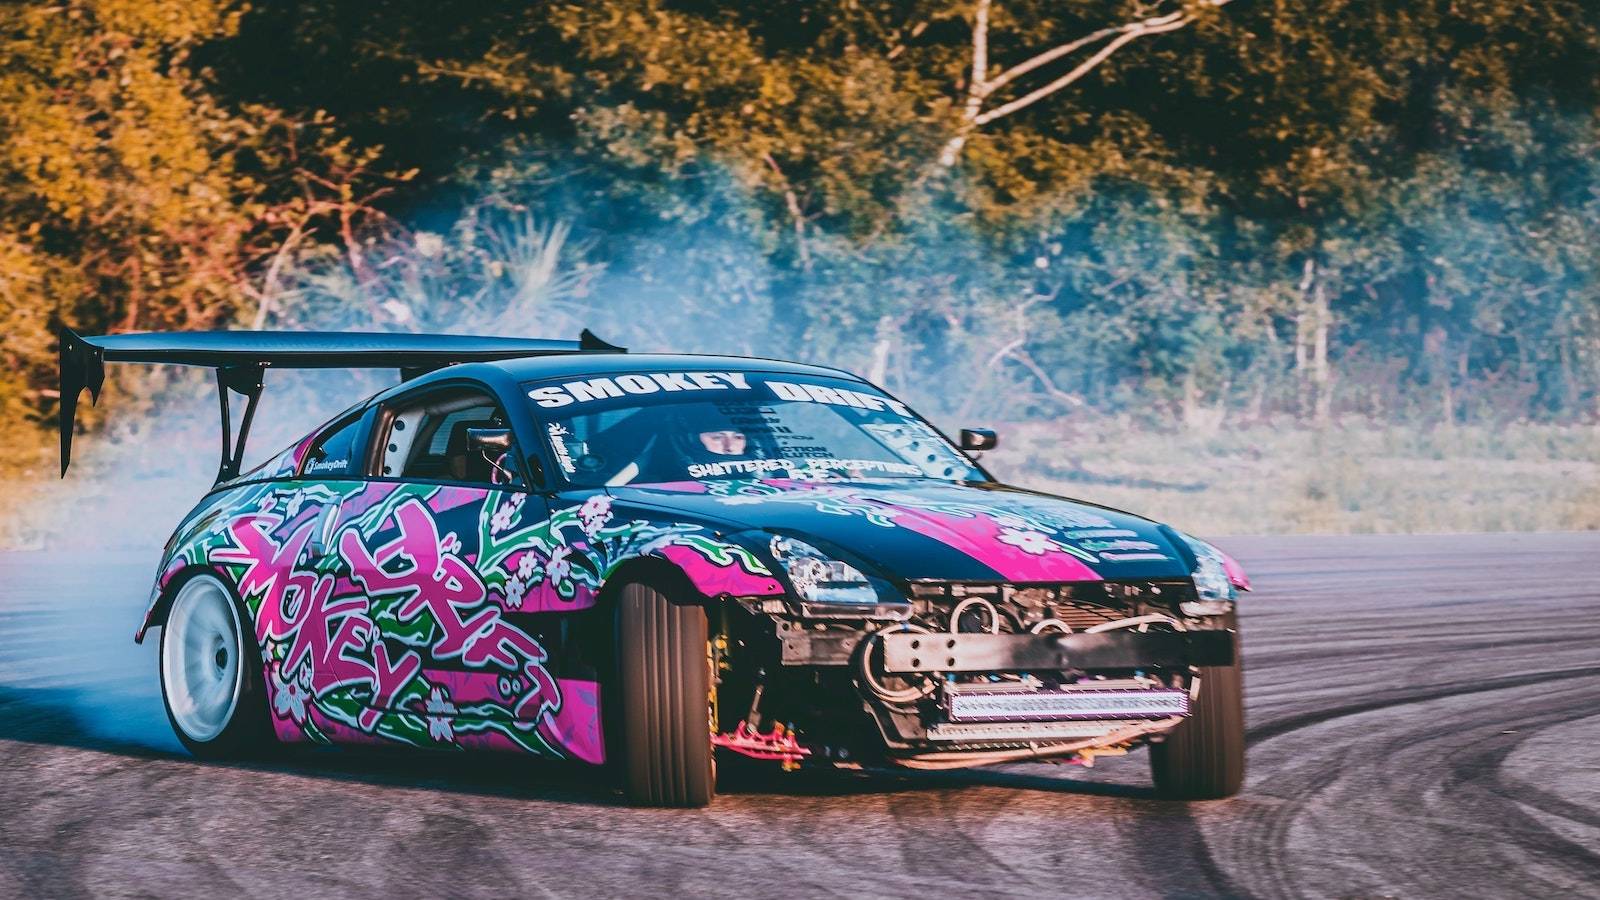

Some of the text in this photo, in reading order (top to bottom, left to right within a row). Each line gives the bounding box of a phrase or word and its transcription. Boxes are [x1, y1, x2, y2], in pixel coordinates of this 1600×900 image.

[528, 371, 914, 418] SMOKEY DRIFT
[687, 459, 795, 478] SHATTERED
